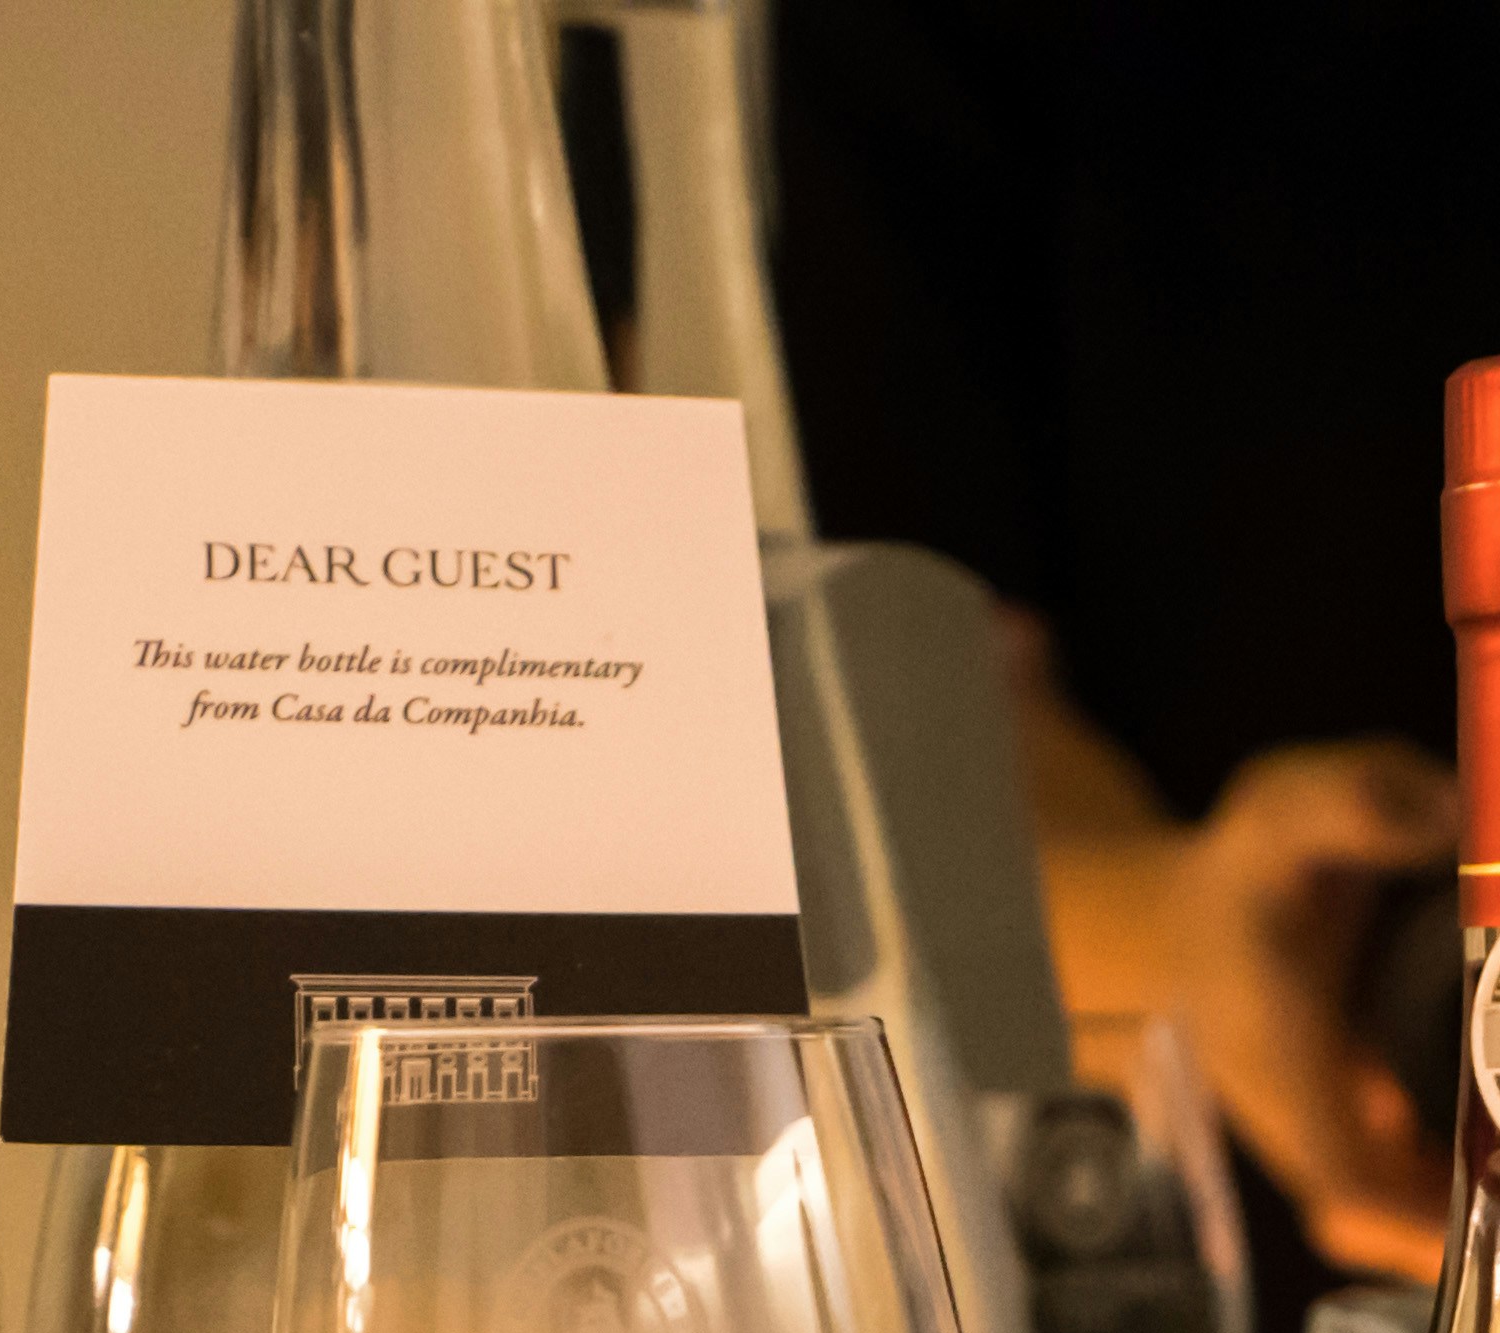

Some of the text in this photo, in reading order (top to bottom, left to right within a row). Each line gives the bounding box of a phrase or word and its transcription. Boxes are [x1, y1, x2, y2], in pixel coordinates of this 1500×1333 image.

[203, 541, 571, 592] DEAR GUEST
[133, 638, 645, 689] This water bottle is complimentary
[182, 688, 586, 735] from Casa da Companhia.
